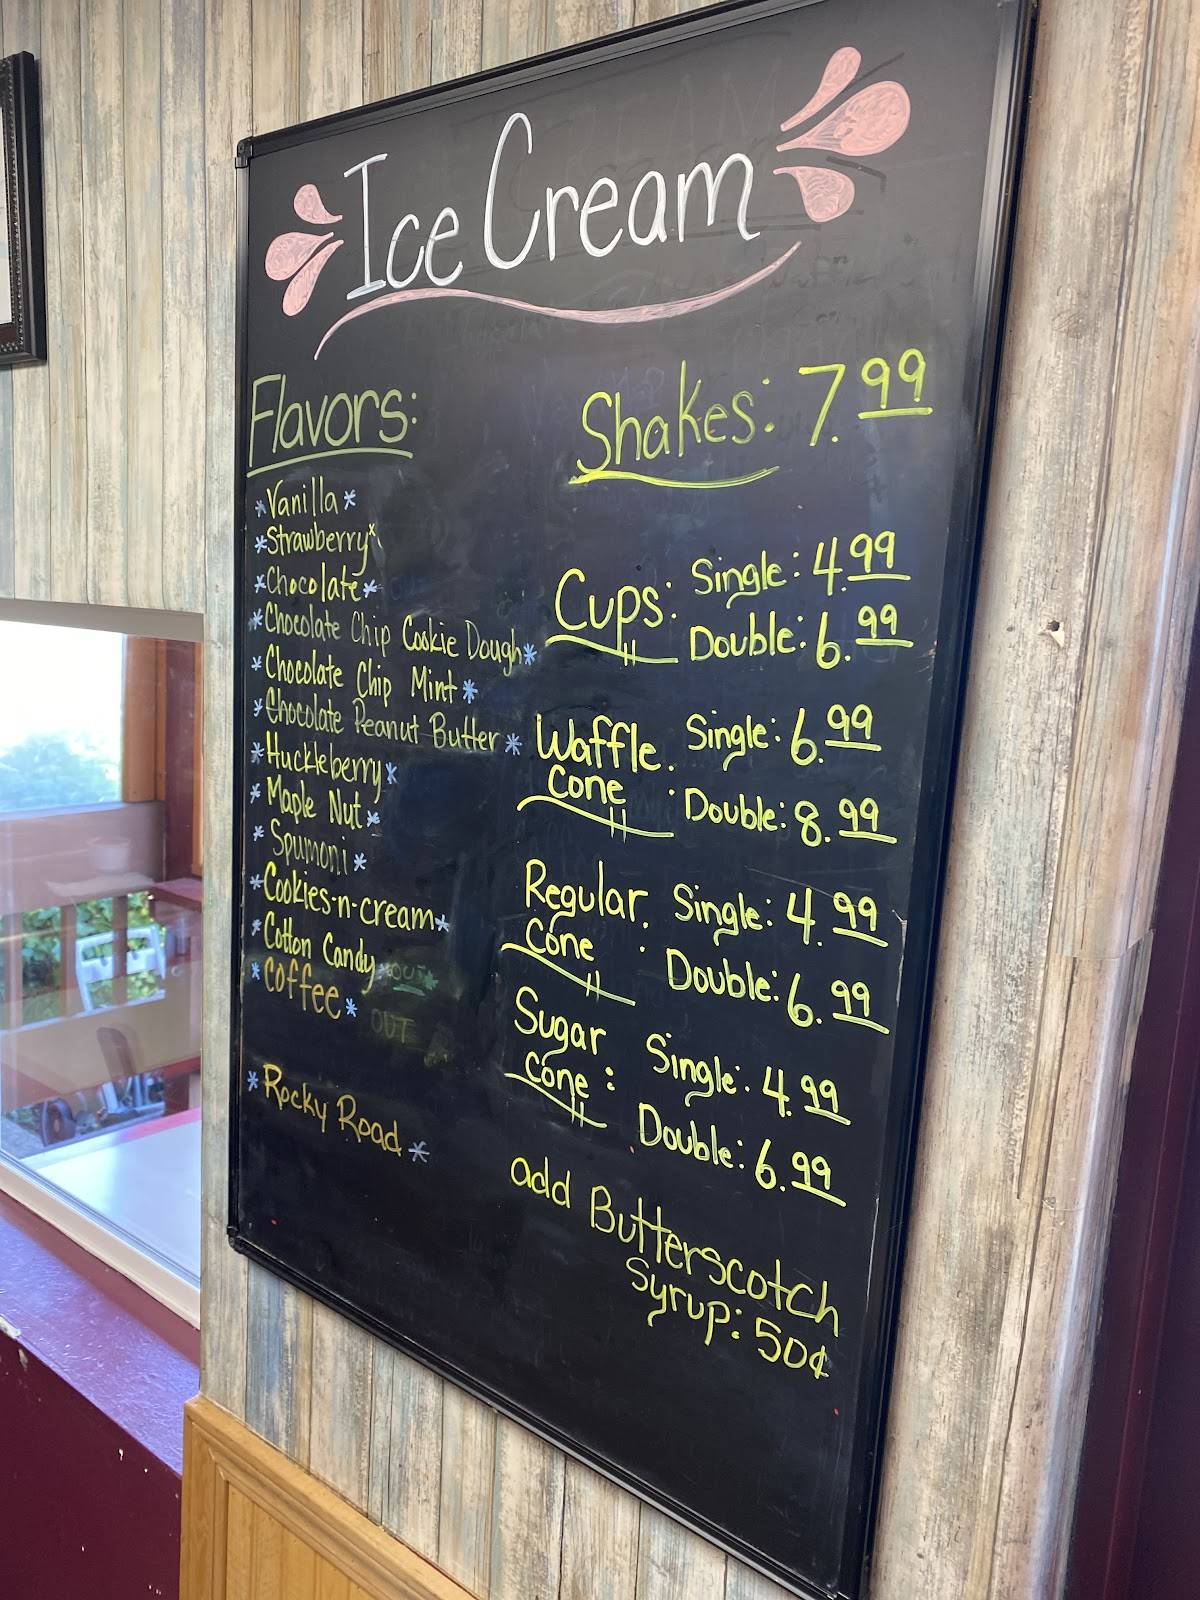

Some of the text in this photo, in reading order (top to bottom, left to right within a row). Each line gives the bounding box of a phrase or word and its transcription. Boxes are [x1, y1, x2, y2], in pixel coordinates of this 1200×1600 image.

[344, 112, 761, 300] Ice Cream
[248, 374, 417, 467] Flavors:
[576, 360, 775, 474] Shakes:
[266, 476, 339, 519] Vanilla
[266, 522, 369, 576] Strawberry
[691, 550, 800, 609] Single:
[266, 562, 361, 602] Chocolate
[555, 568, 677, 652] Cups:
[265, 601, 523, 677] Chocolate Chip Cookie Dough
[691, 611, 806, 661] Double:
[265, 644, 458, 707] Chocolate Chip Mint
[266, 687, 500, 752] Chocolate Peanut Butter
[687, 710, 780, 771] Single:
[266, 731, 382, 803] Huckleberry
[267, 776, 362, 829] Maple Nut
[685, 787, 786, 832] Double:
[270, 818, 348, 876] Spumoni
[673, 883, 773, 946] Single:
[263, 911, 312, 959] Cotton
[323, 932, 376, 995] Candy
[666, 948, 780, 1002] Double:
[264, 956, 341, 1020] Coffee
[515, 986, 607, 1067] Sugar
[646, 1033, 751, 1107] Single:
[263, 1064, 402, 1157] Rocky Road
[639, 1103, 745, 1170] Double:
[590, 1185, 839, 1337] Butterscotch
[755, 1317, 829, 1379] 50¢
